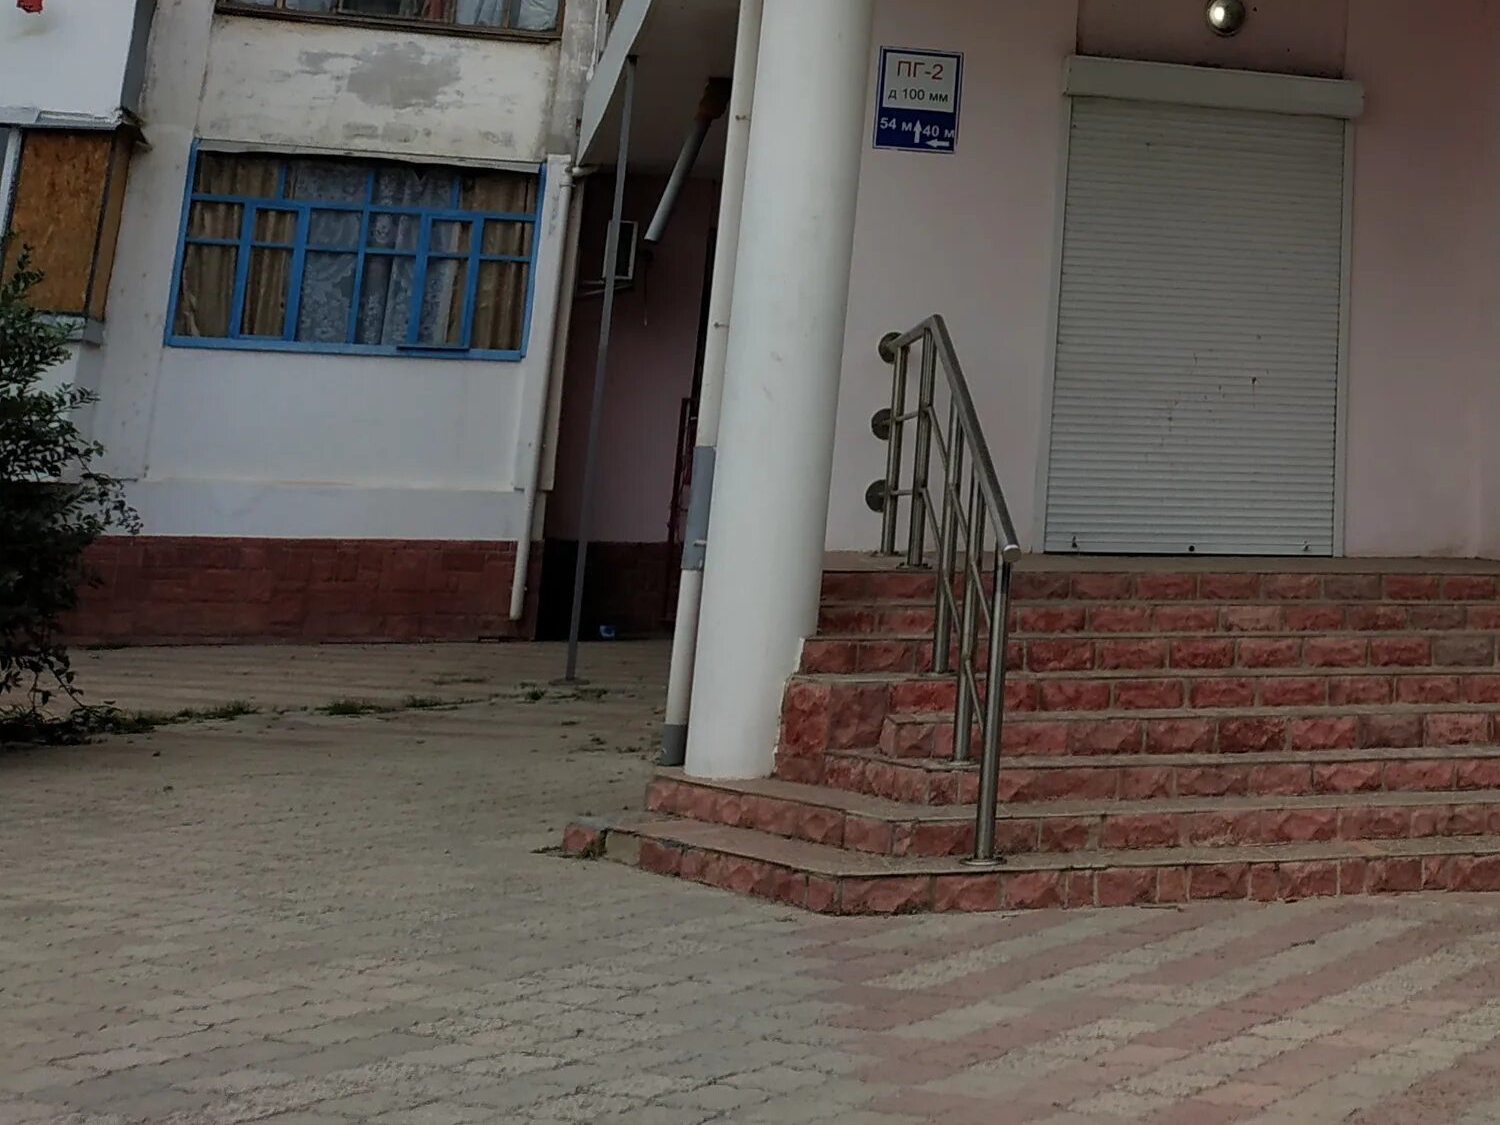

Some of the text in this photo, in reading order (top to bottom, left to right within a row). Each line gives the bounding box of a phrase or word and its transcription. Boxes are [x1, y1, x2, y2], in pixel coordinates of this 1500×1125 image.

[896, 60, 944, 81] ПГ-2
[902, 87, 926, 101] 100
[929, 92, 949, 103] мм
[880, 117, 897, 130] 54
[922, 124, 940, 138] 40
